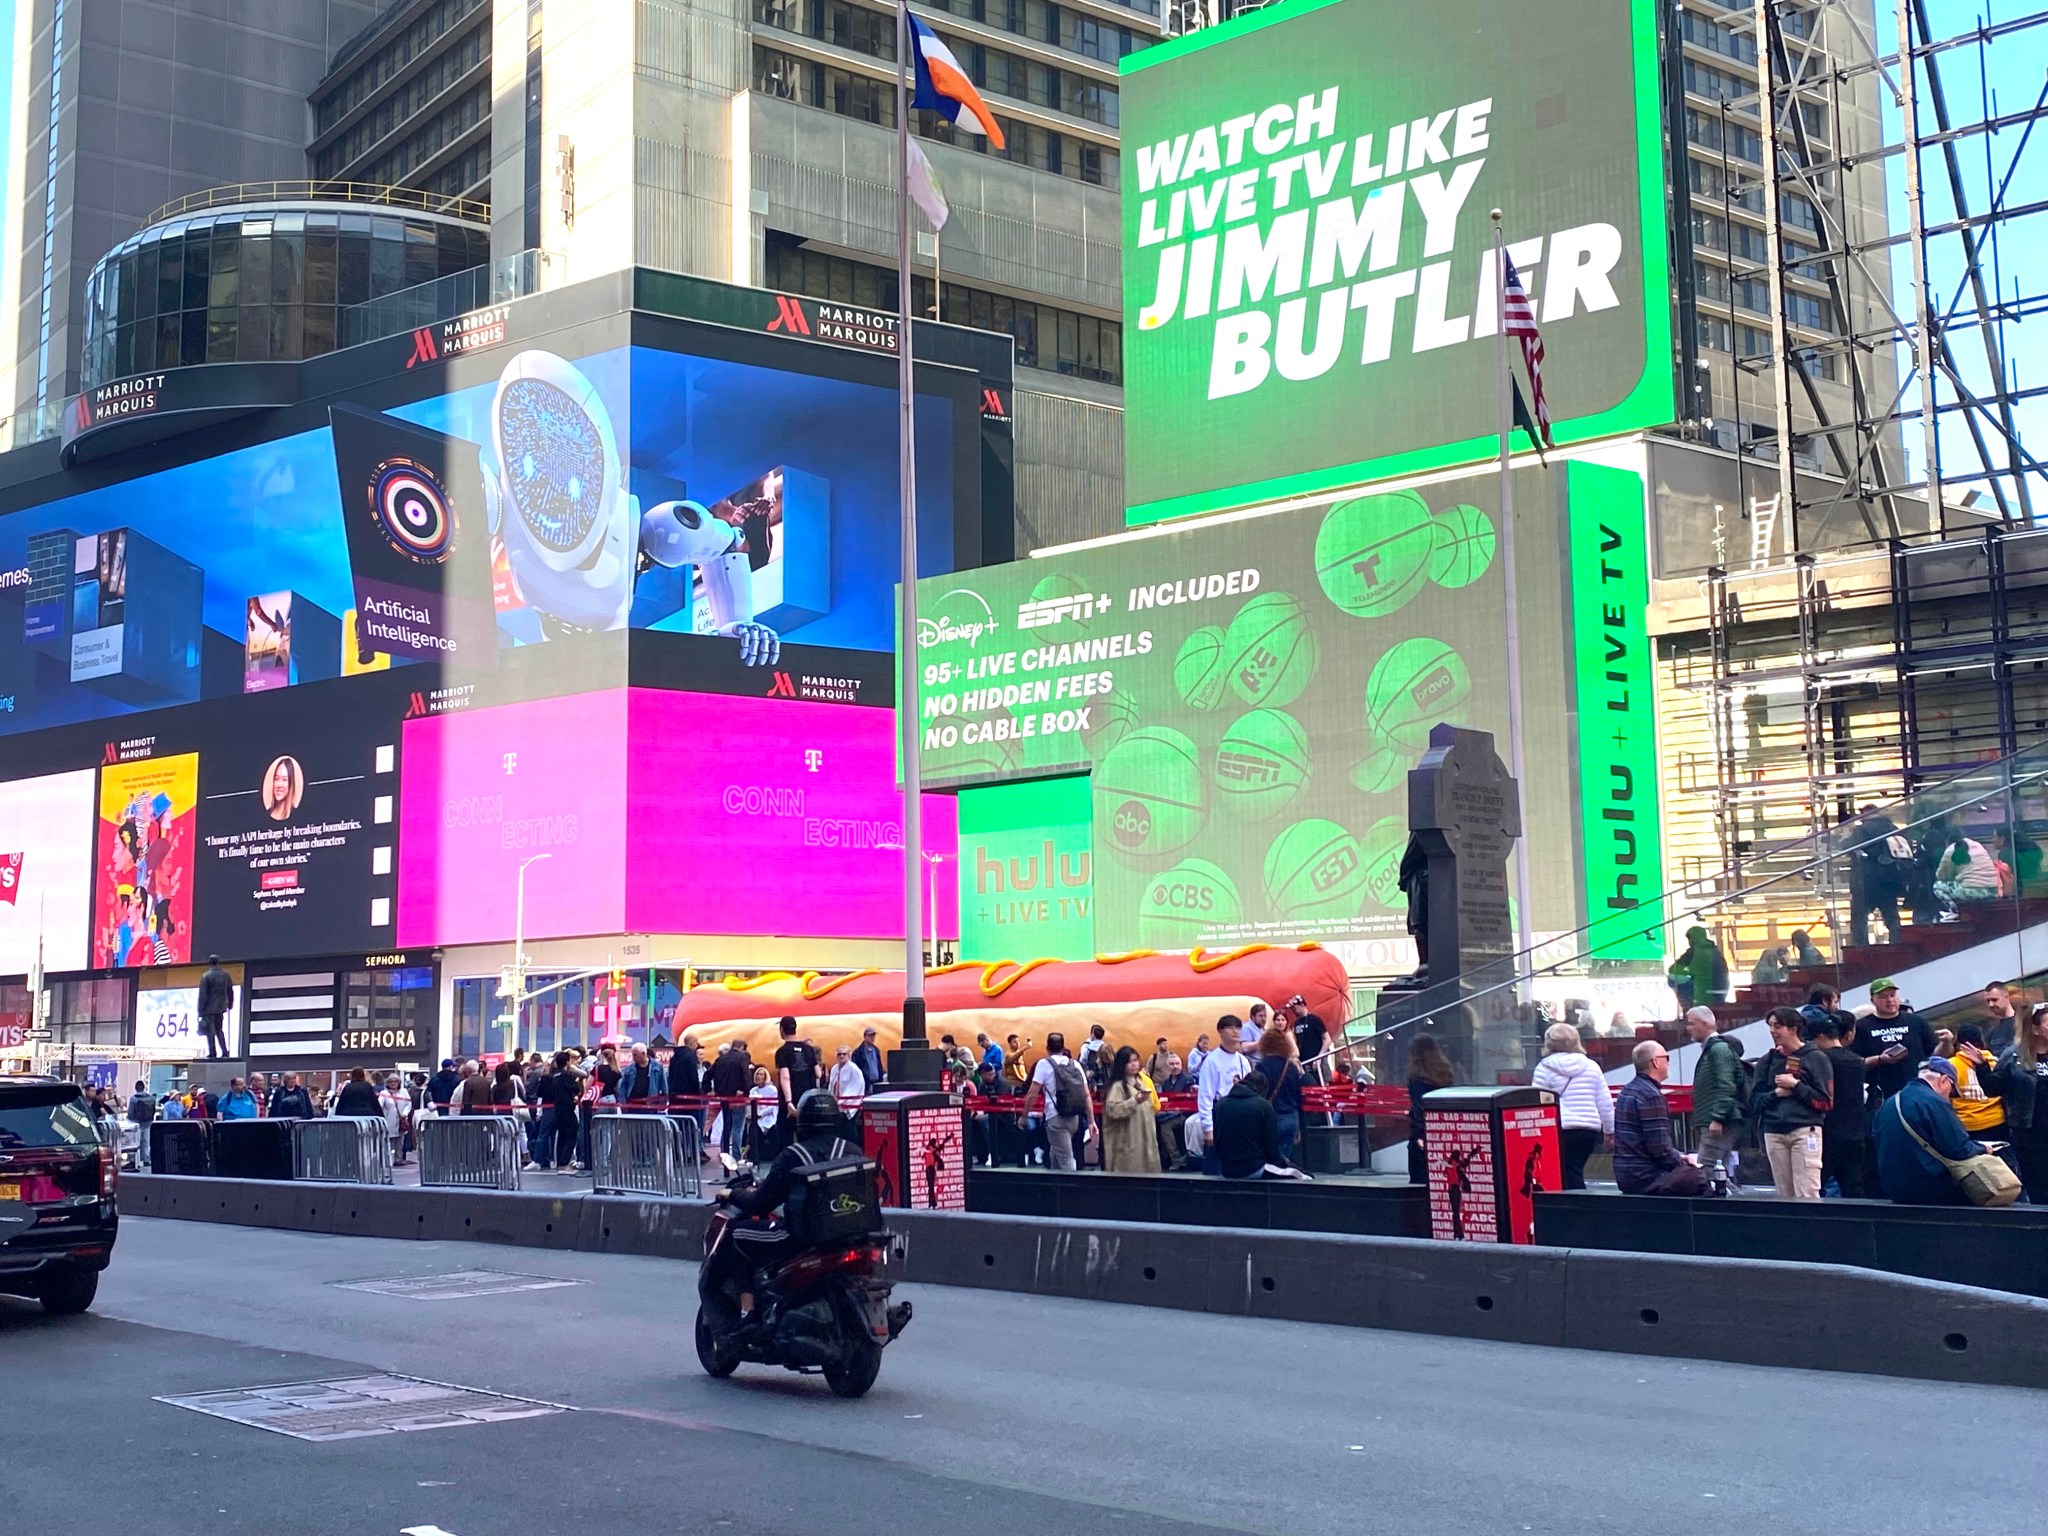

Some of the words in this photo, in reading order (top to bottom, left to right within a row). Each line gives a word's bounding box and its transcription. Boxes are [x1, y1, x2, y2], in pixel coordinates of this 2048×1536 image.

[1137, 86, 1339, 192] WATCH
[1138, 167, 1259, 248] LIVE
[1267, 142, 1346, 210] TV
[1351, 98, 1492, 188] LIKE
[1139, 158, 1486, 331] JIMMY
[445, 307, 510, 336] MARRIOTT
[820, 306, 900, 330] MARRIOT
[444, 327, 502, 353] MARQUIS
[820, 323, 896, 348] MARQUIS
[97, 375, 165, 402] MARRIOTT
[96, 395, 154, 420] MARQUIS
[1599, 523, 1623, 584] TV
[1017, 592, 1111, 630] ESPN+
[1128, 568, 1260, 612] INCLUDED
[1352, 579, 1396, 603] TELEMUNDO
[364, 597, 430, 625] Artificial
[367, 619, 457, 651] Intelligence
[74, 640, 104, 656] Consumer
[924, 664, 963, 686] 95+
[967, 652, 1016, 680] LIVE
[1021, 631, 1153, 672] CHANNELS
[1604, 603, 1630, 712] LIVE
[73, 657, 100, 671] Business
[101, 653, 119, 666] Travel
[430, 685, 475, 700] MARRIOTT
[802, 676, 861, 689] MARRIOTT
[802, 688, 854, 700] MARQUIS
[924, 694, 957, 718] NO
[962, 682, 1050, 713] HIDDEN
[1056, 671, 1113, 701] FEES
[1415, 674, 1450, 702] bravo
[430, 697, 469, 711] MARQUIS
[924, 727, 958, 751] NO
[962, 715, 1034, 746] CABLE
[1041, 707, 1091, 735] BOX
[120, 748, 151, 760] MARQUIS
[121, 737, 155, 749] MARRIOTT
[1217, 751, 1281, 783] ESPN
[443, 795, 502, 828] CONN
[723, 785, 804, 817] CONN
[230, 834, 240, 844] my
[258, 829, 283, 841] heritage
[284, 828, 292, 839] by
[293, 824, 322, 836] breaking
[323, 819, 362, 834] boundaries.
[502, 814, 578, 849] ECTING
[804, 818, 900, 849] ECTING
[1113, 811, 1150, 835] abc
[229, 845, 248, 857] finally
[249, 844, 264, 855] time
[265, 843, 272, 853] to
[273, 842, 281, 852] be
[281, 840, 292, 851] the
[293, 838, 309, 850] main
[311, 836, 345, 848] characters
[1603, 764, 1639, 910] hulu
[250, 858, 258, 868] of
[258, 858, 269, 867] our
[270, 857, 284, 866] own
[977, 841, 1091, 894] hulu
[1314, 850, 1353, 887] FS1
[1168, 883, 1214, 911] CBS
[995, 900, 1049, 924] LIVE
[1058, 897, 1090, 920] TV
[1254, 921, 1280, 930] Regional
[1364, 914, 1396, 922] additional
[1197, 933, 1217, 941] Access
[1218, 932, 1240, 940] content
[1272, 929, 1294, 937] service
[1333, 926, 1349, 934] 2024
[1351, 925, 1371, 933] Disney
[366, 954, 405, 967] SEPHORA
[622, 945, 640, 955] 1535
[156, 1013, 188, 1038] 654
[1871, 1026, 1909, 1037] BROADWAY
[1881, 1034, 1903, 1042] CREW
[341, 1030, 416, 1049] SEPHORA
[1425, 1112, 1439, 1120] JAM
[1444, 1112, 1459, 1121] BAD
[1463, 1113, 1489, 1121] MONEY
[1426, 1122, 1455, 1131] SMOOTH
[1456, 1122, 1490, 1131] CRIMINAL
[1428, 1152, 1443, 1160] CAN
[943, 1184, 964, 1192] ABC
[1432, 1211, 1454, 1220] BEAT
[1470, 1213, 1496, 1222] ABC
[1433, 1221, 1454, 1230] HUMA
[1465, 1222, 1497, 1232] NATURE
